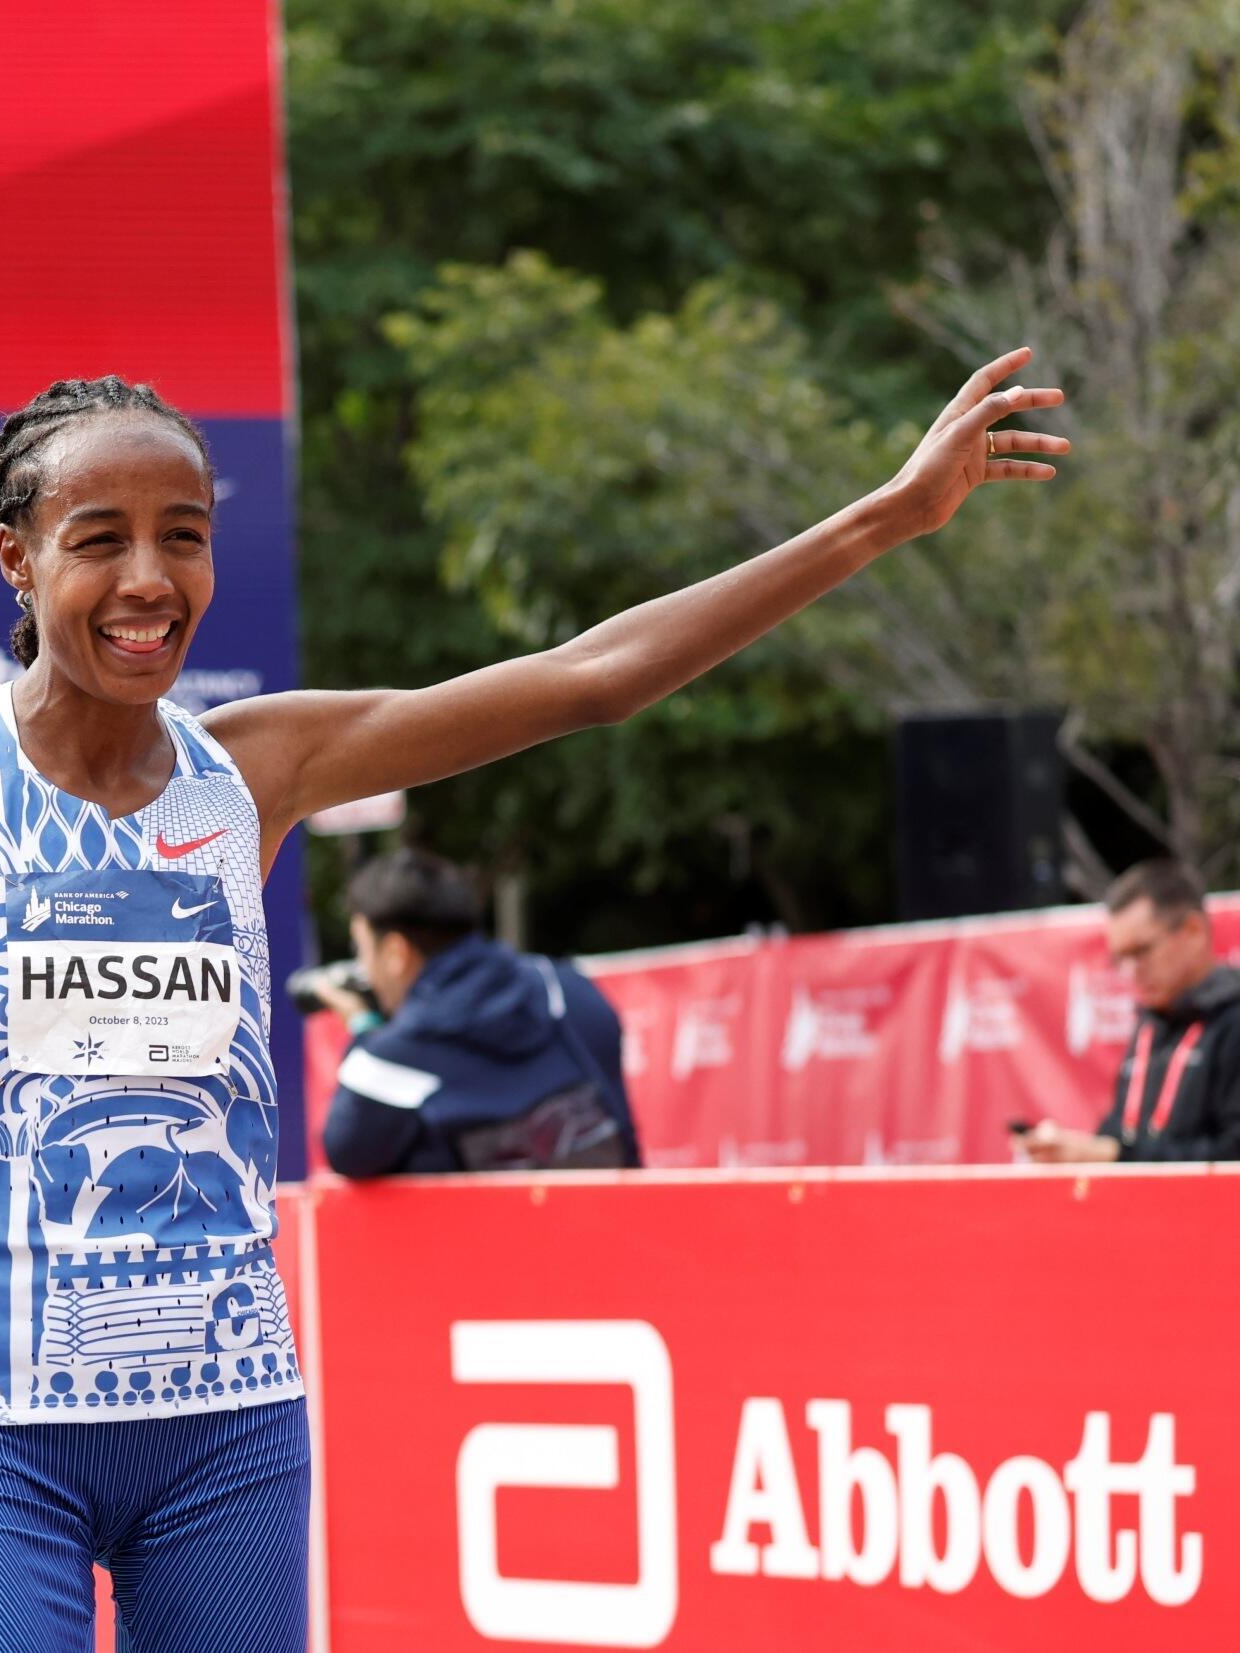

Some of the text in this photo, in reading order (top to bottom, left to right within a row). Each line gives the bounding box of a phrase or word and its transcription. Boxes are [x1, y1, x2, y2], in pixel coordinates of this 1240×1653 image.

[54, 900, 102, 915] Chicago
[21, 954, 231, 1003] HASSAN
[89, 1015, 169, 1026] October 8, 2023
[710, 1396, 1204, 1607] Abbott
